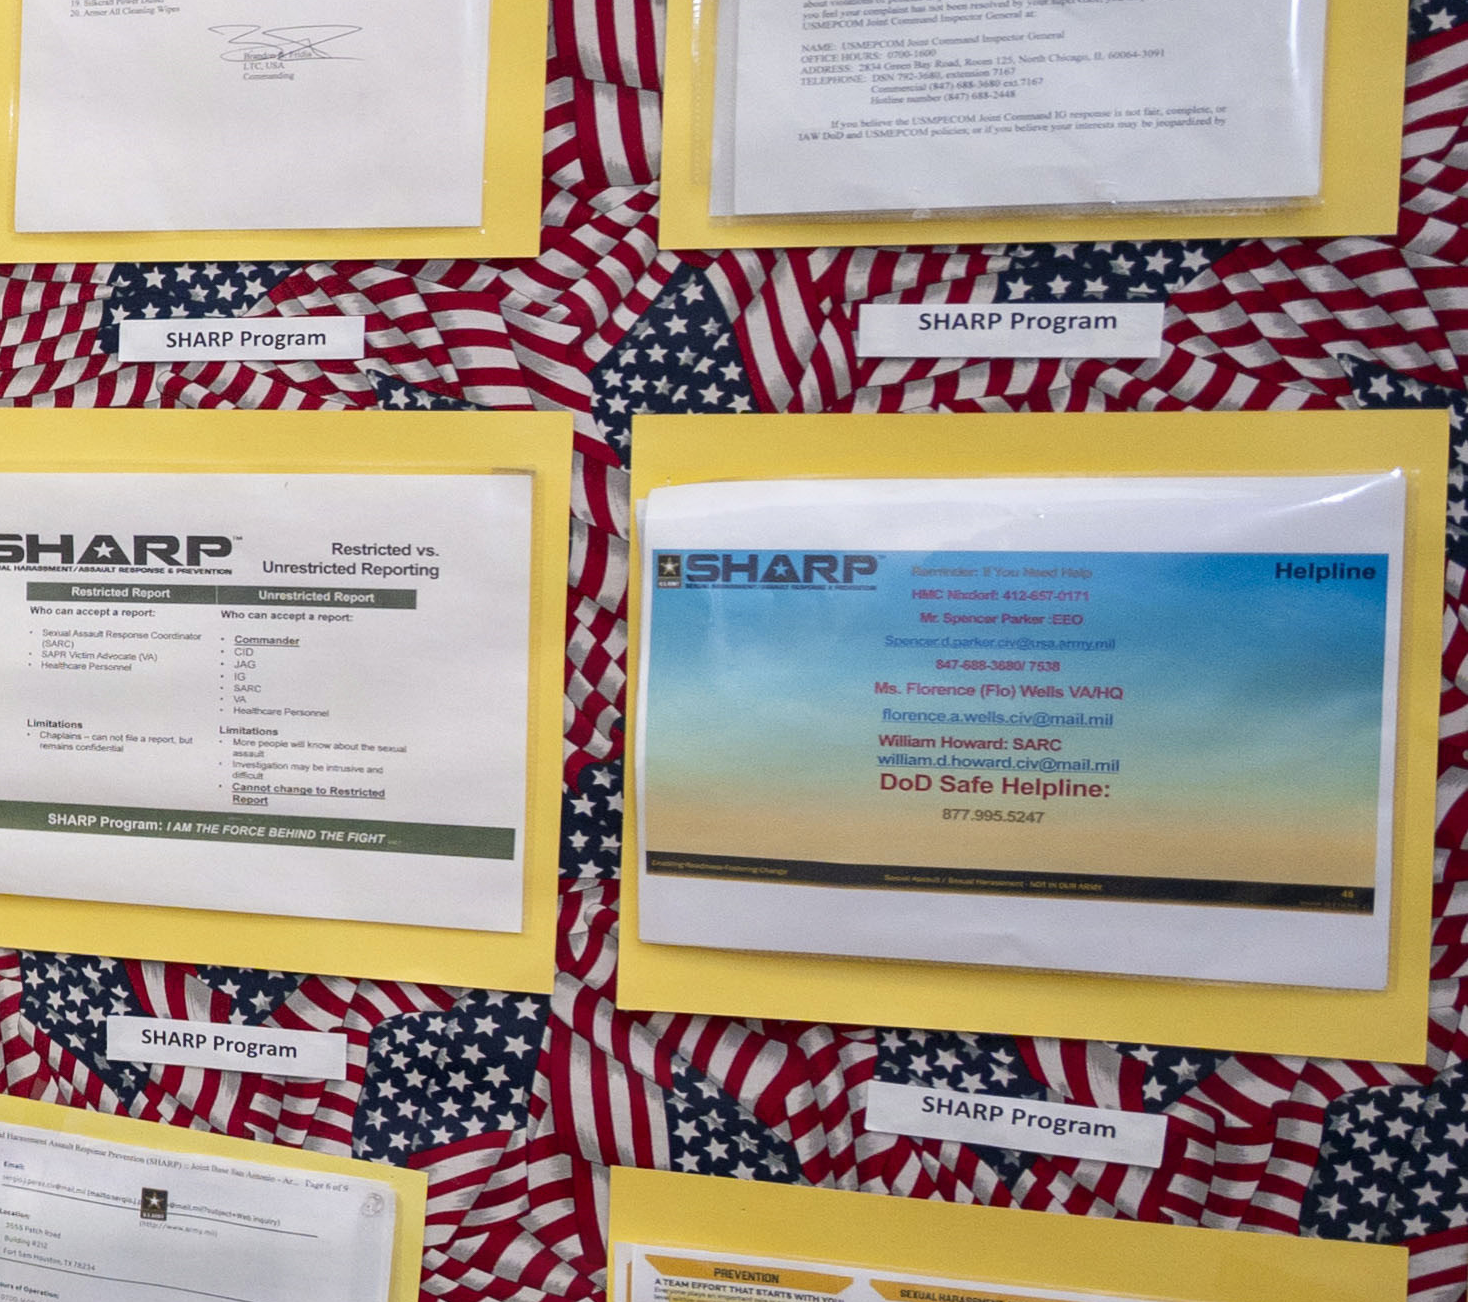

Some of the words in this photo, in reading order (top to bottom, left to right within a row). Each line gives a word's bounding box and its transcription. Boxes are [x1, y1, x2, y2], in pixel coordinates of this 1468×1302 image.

[918, 312, 1002, 331] SHARP
[1009, 311, 1118, 335] Program
[166, 329, 234, 348] SHARP
[239, 329, 327, 351] Program
[332, 542, 411, 557] Restricted
[416, 546, 440, 557] vs.
[262, 560, 357, 576] Unrestricted
[361, 562, 440, 580] Reporting
[685, 553, 879, 585] SHARP
[1275, 561, 1377, 583] Helpline
[71, 586, 129, 598] Restricted
[132, 587, 171, 600] Report
[258, 590, 331, 602] Unrestricted
[334, 592, 375, 605] Report
[30, 605, 52, 615] Who
[55, 608, 73, 616] can
[76, 607, 110, 618] accept
[121, 609, 156, 619] report:
[221, 610, 245, 620] Who
[248, 612, 267, 620] can
[270, 611, 306, 622] accept
[318, 612, 354, 623] report:
[943, 612, 997, 626] Spencer
[1001, 613, 1045, 625] Parker
[234, 635, 300, 647] Commander
[234, 647, 254, 657] CID
[234, 660, 256, 669] JAG
[874, 681, 901, 695] Ms.
[906, 682, 976, 696] Florence
[980, 684, 1017, 699] (Flo)
[1021, 685, 1064, 698] Wells
[1069, 686, 1124, 700] VA/HQ
[882, 707, 1114, 728] florence.a.wells.civ@mail.mil
[878, 734, 936, 748] William
[941, 735, 1008, 750] Howard:
[1012, 738, 1062, 752] SARC
[877, 753, 1120, 774] william.d.howard.civ@mail.mil
[880, 773, 932, 792] DoD
[939, 775, 994, 794] Safe
[1002, 776, 1111, 800] Helpline:
[942, 808, 1045, 824] 877.995.5247
[47, 813, 97, 828] SHARP
[100, 816, 164, 833] Program:
[173, 821, 192, 833] AM
[196, 823, 219, 835] THE
[222, 824, 266, 837] FORCE
[268, 826, 316, 840] BEHIND
[320, 829, 344, 842] THE
[347, 831, 386, 844] FIGHT
[140, 1028, 208, 1050] SHARP
[212, 1034, 298, 1059] Program
[921, 1094, 1004, 1123] SHARP
[1010, 1106, 1118, 1139] Program
[714, 1267, 780, 1284] PREVENTION
